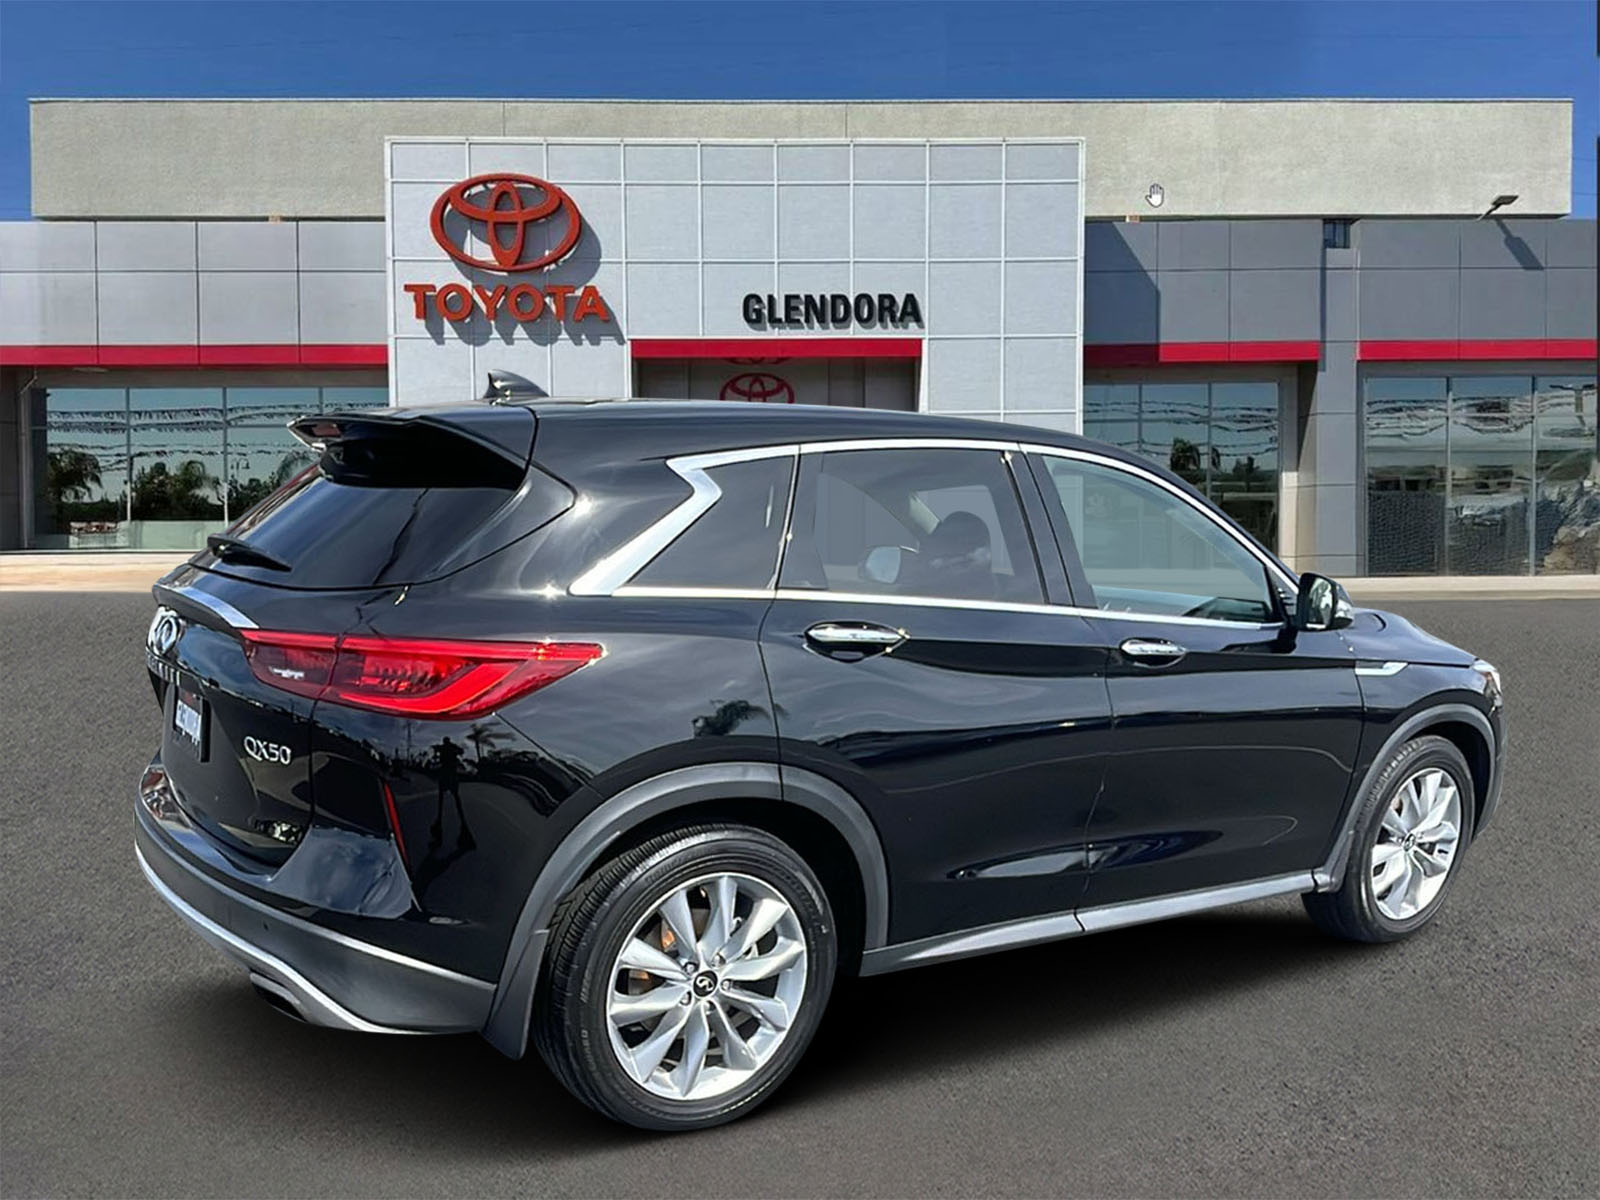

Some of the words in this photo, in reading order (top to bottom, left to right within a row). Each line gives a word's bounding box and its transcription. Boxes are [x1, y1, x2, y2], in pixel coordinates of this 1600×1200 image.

[404, 283, 611, 323] TOYOTA
[742, 293, 923, 325] GLENDORA
[243, 735, 292, 765] QX50
